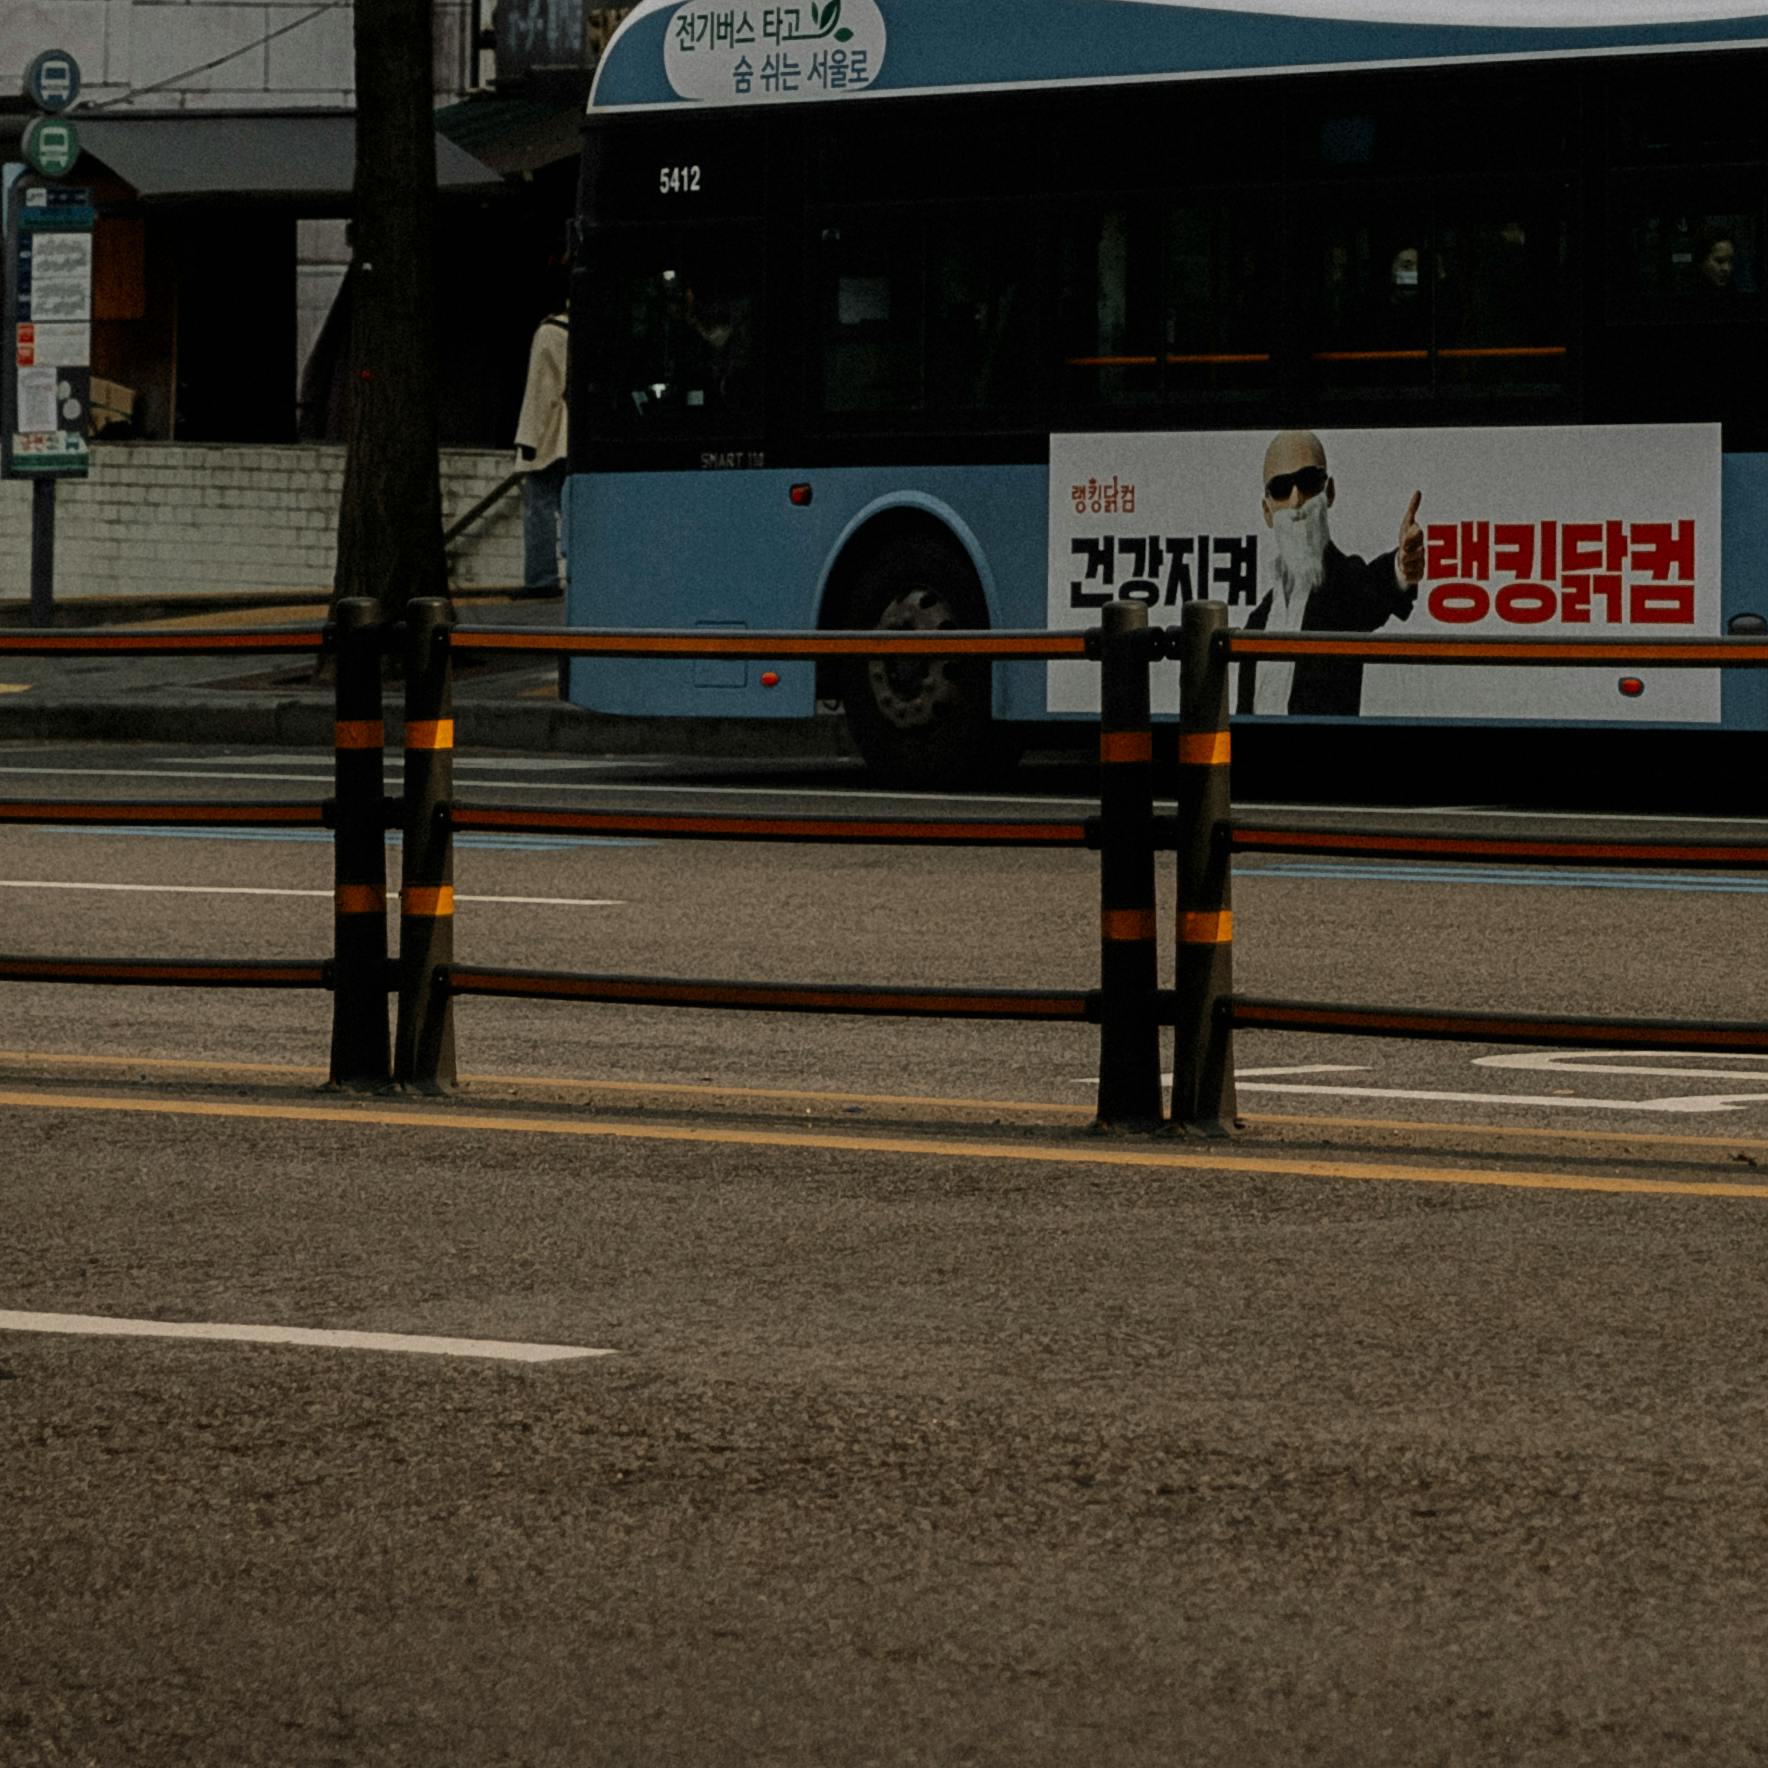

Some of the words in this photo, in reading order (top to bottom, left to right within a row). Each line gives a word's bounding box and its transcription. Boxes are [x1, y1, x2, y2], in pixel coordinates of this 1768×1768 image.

[675, 10, 756, 52] 전기버스
[763, 7, 802, 46] 타고
[733, 54, 754, 94] 숨
[760, 52, 802, 92] 쉬는
[807, 48, 870, 89] 서울로
[658, 165, 702, 195] 5412
[1072, 475, 1136, 514] 랭킹닭컴
[1070, 535, 1258, 609] 건강지켜
[1425, 518, 1696, 625] 랭킹닭컴
